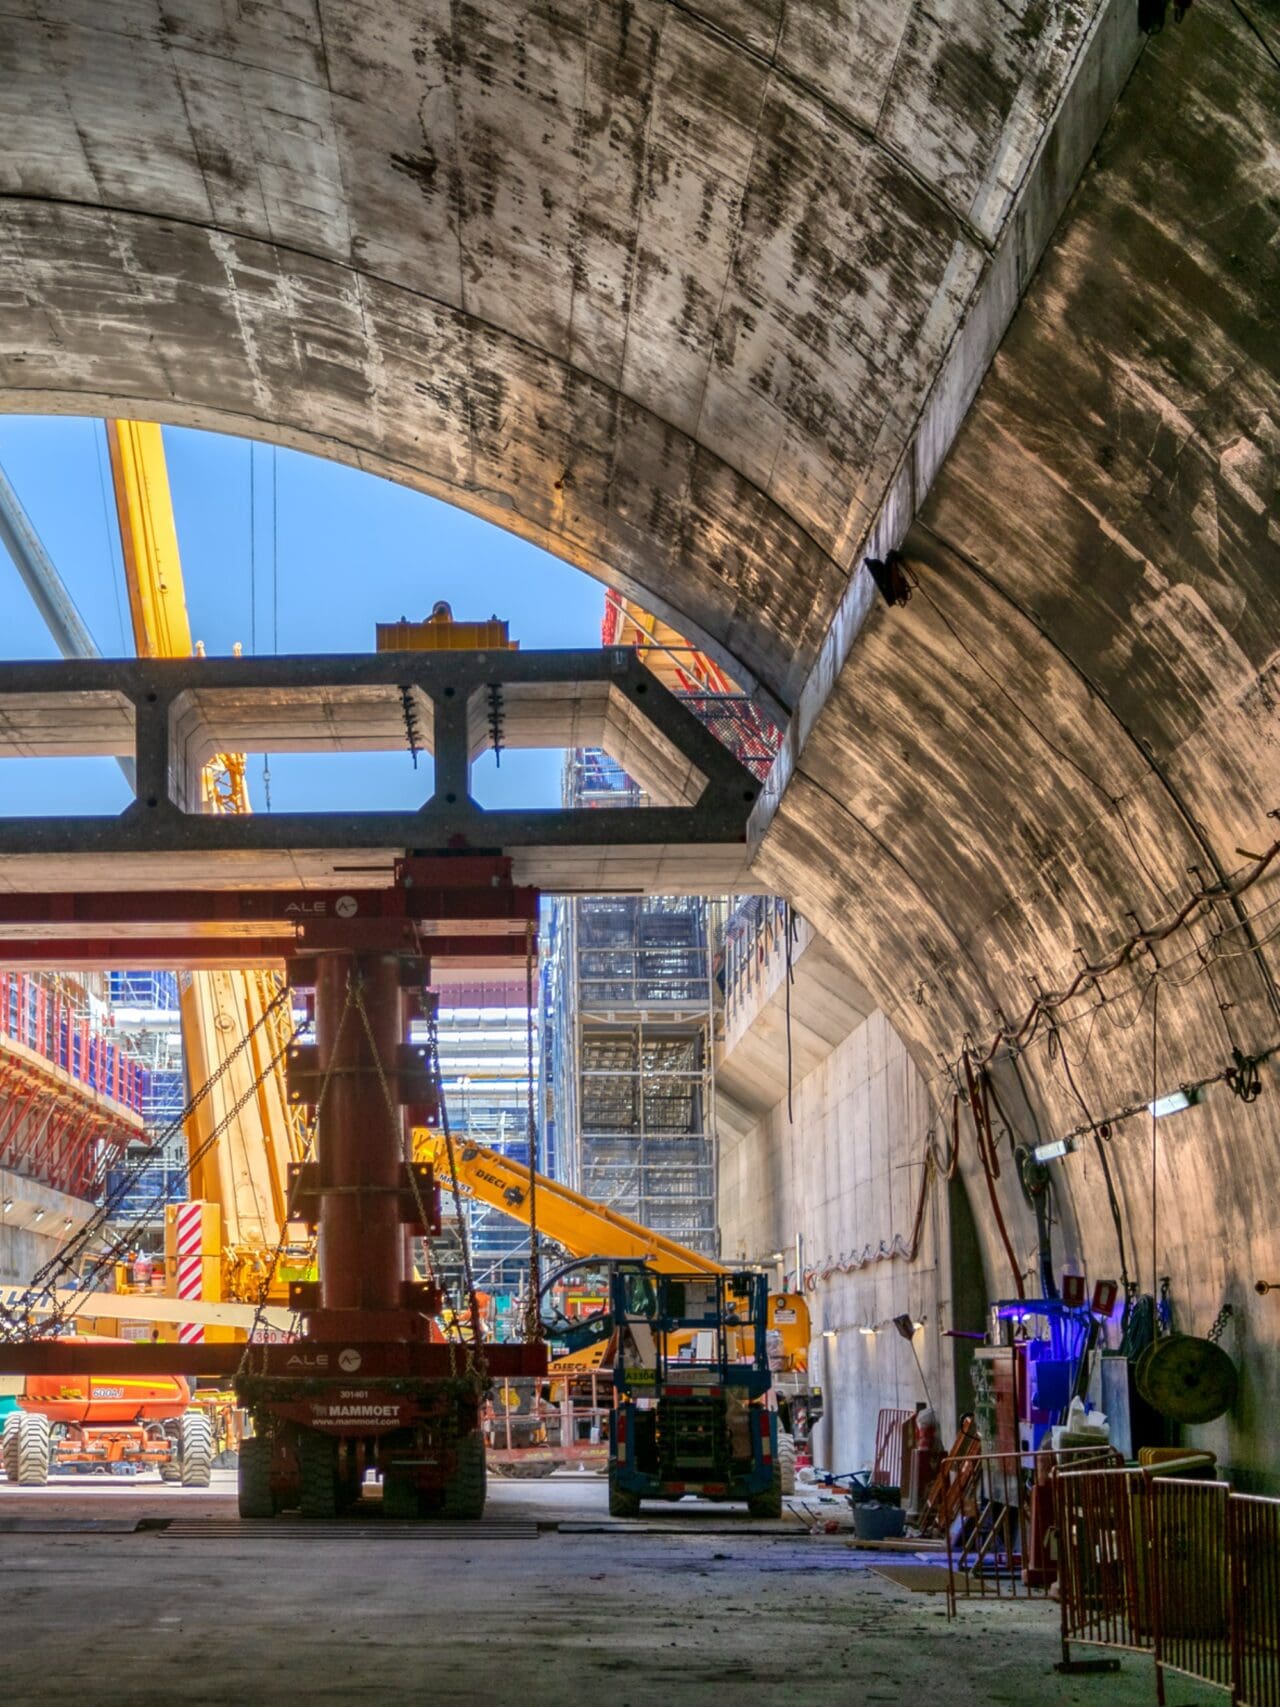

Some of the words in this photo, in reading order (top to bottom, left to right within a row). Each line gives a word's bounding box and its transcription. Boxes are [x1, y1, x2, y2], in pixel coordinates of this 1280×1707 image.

[285, 901, 326, 912] ALE
[476, 1168, 506, 1189] DIECI
[287, 1354, 329, 1366] ALE
[329, 1405, 401, 1417] MAMMOET
[311, 1418, 401, 1427] www.mammoet.com
